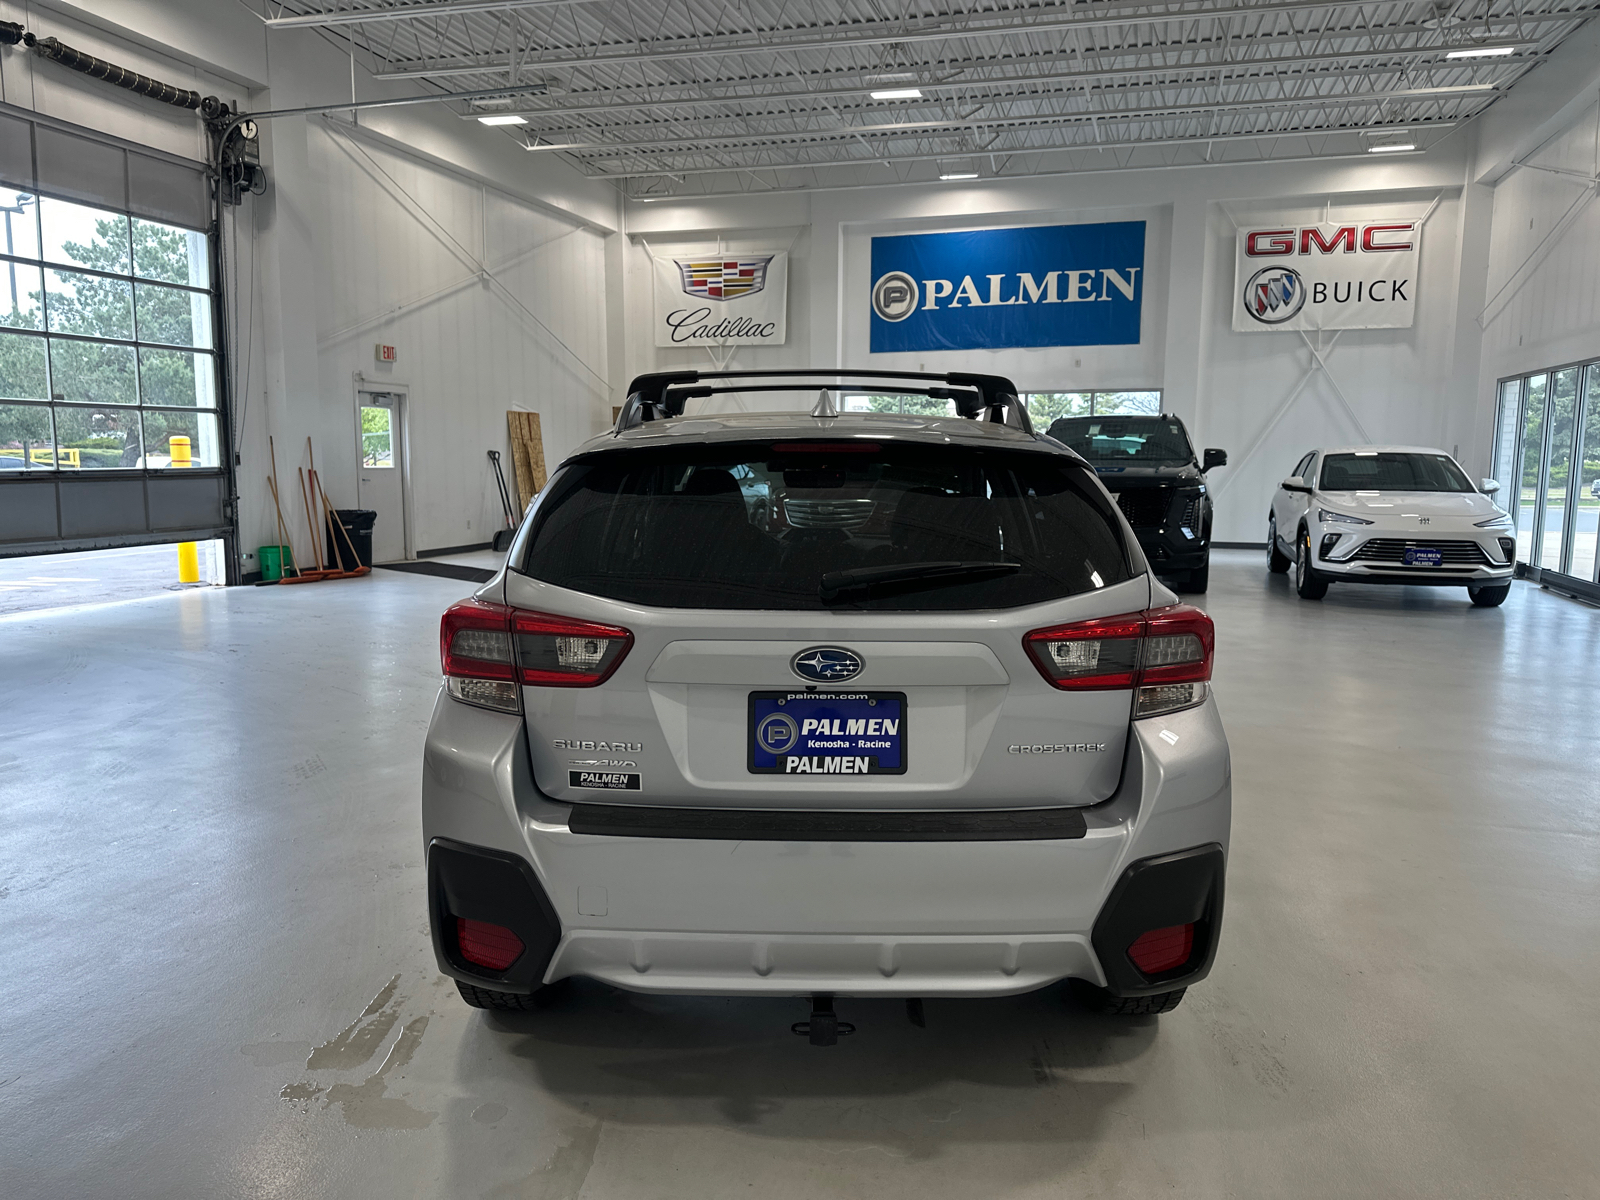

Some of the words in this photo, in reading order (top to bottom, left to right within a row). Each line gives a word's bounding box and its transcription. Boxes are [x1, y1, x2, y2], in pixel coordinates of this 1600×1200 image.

[1245, 222, 1414, 258] GMC
[920, 267, 1141, 311] PALMEN
[1312, 279, 1409, 304] BUICK
[666, 307, 775, 342] Cadillac
[383, 345, 394, 360] EXIT
[801, 718, 899, 736] PALMEN
[553, 739, 642, 752] SUBARU
[807, 740, 850, 749] Kenosha
[858, 740, 891, 749] Racine
[1008, 743, 1106, 754] CROSSTREK
[594, 759, 638, 767] AWD
[786, 756, 869, 773] PALMEN
[580, 773, 629, 784] PALMEN
